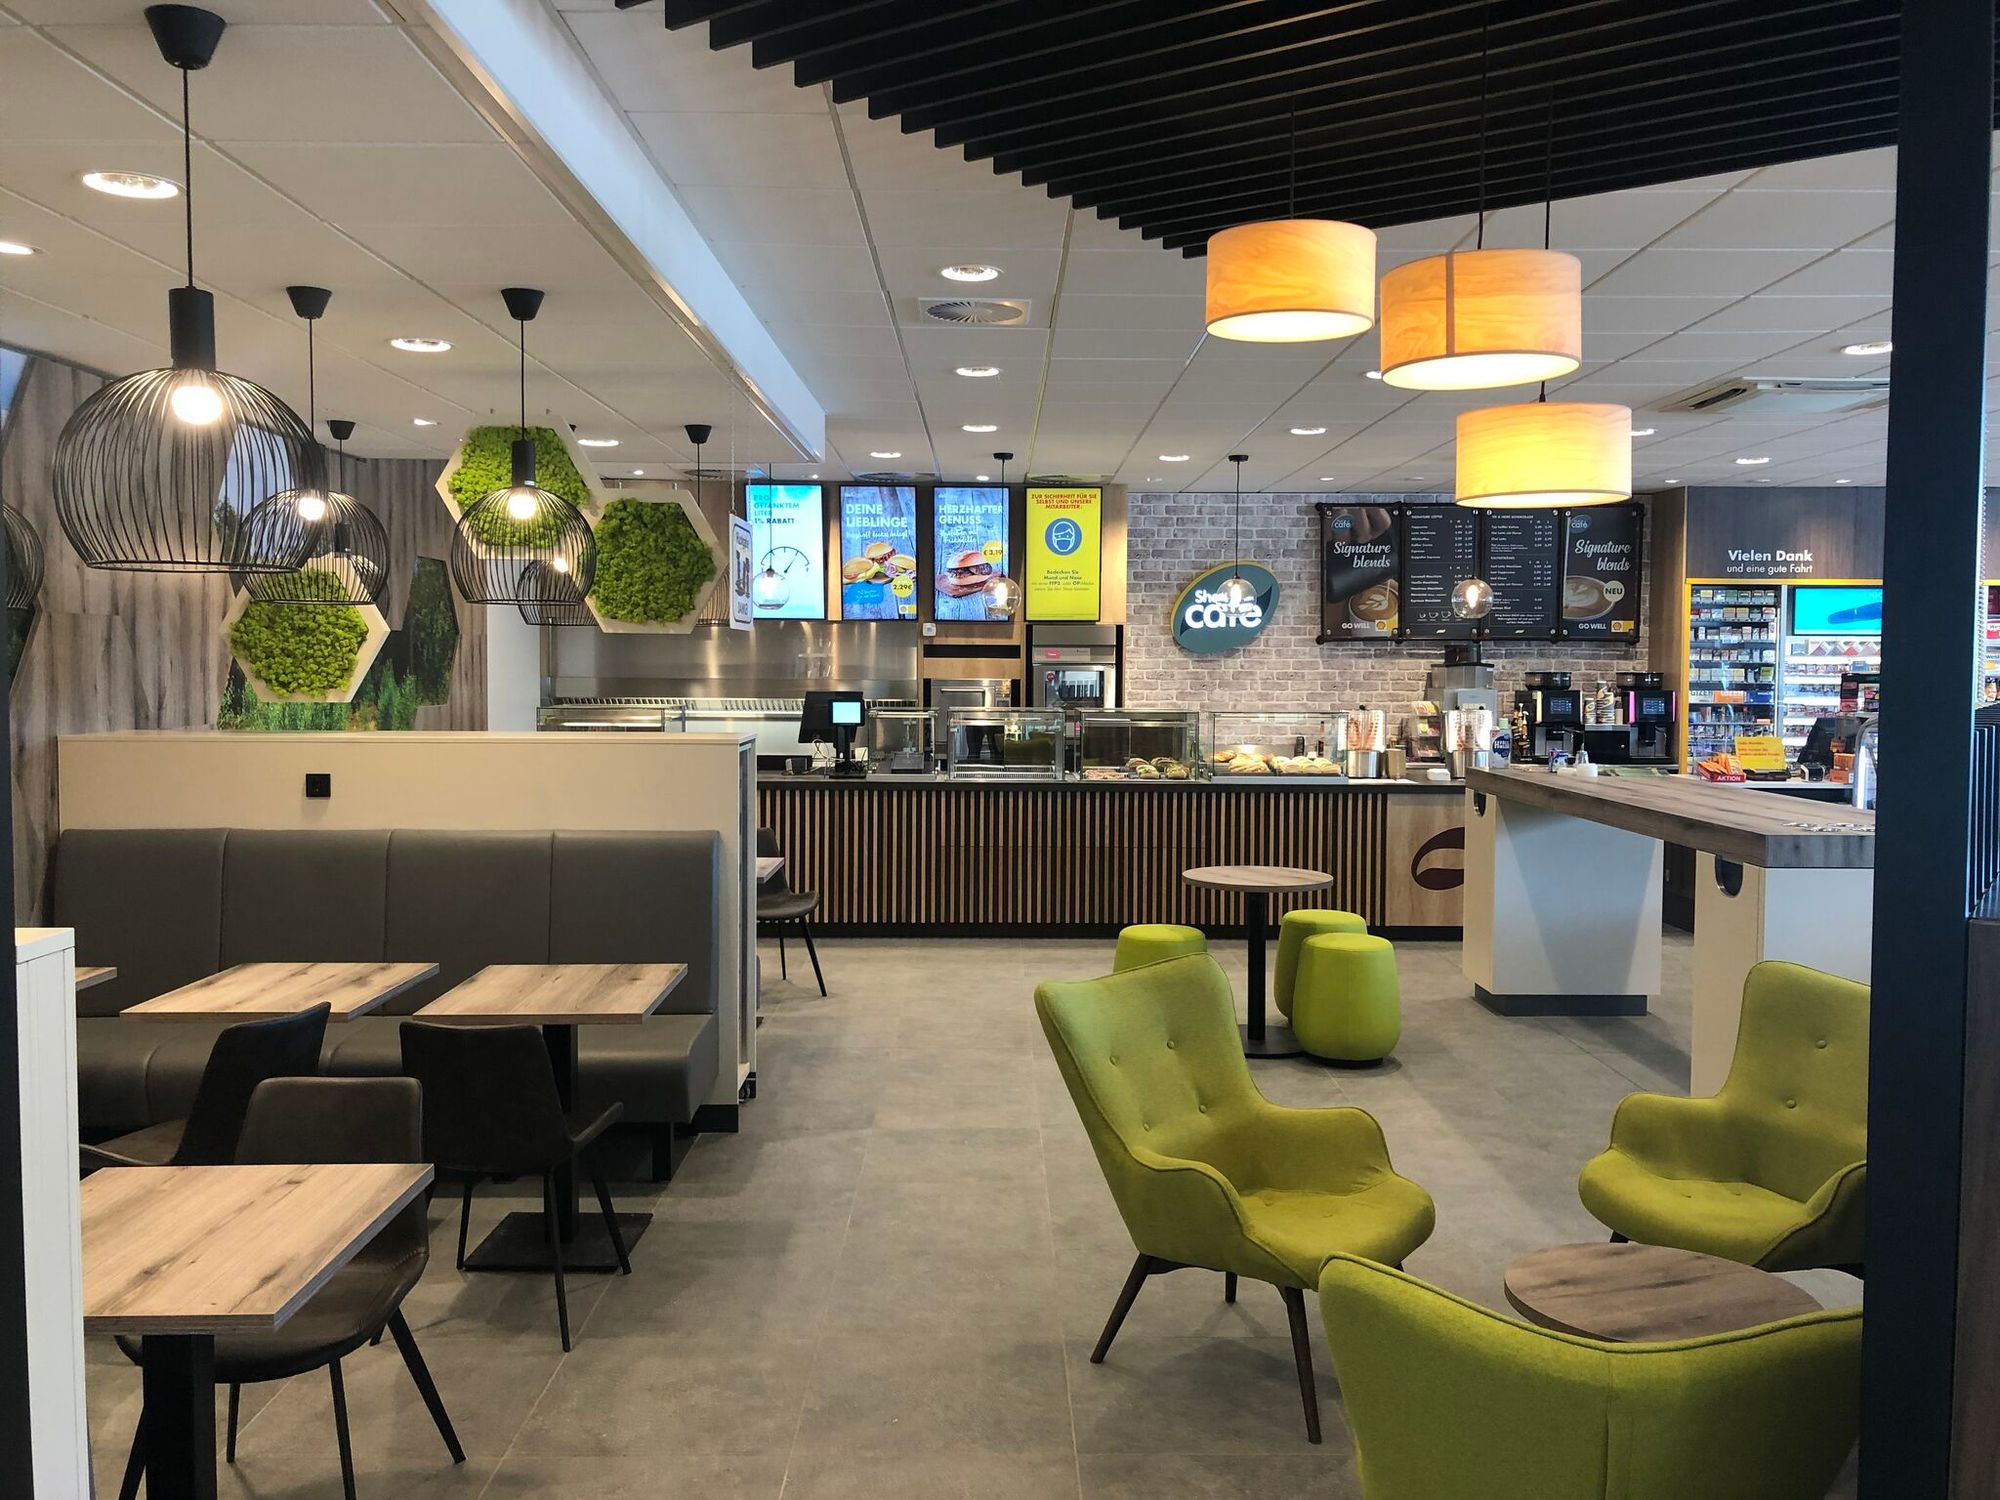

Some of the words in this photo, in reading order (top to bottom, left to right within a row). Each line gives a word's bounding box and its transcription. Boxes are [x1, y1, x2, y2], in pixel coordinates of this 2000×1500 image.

[845, 503, 884, 515] DEINE
[938, 504, 1003, 514] HERZHAFTER
[845, 516, 908, 528] LIEBLINGE
[938, 515, 982, 525] GENUSS
[1334, 520, 1351, 529] café
[1571, 520, 1588, 529] café
[1333, 541, 1392, 557] Signature
[1574, 539, 1632, 558] Signature
[1728, 549, 1772, 561] Vielen
[1776, 549, 1813, 561] Dank
[1352, 555, 1391, 568] blends
[1596, 557, 1631, 571] blends
[1726, 563, 1744, 573] und
[1746, 564, 1765, 573] eine
[1767, 565, 1787, 575] gute
[1789, 563, 1813, 573] Fahrt
[1604, 587, 1623, 595] NEU
